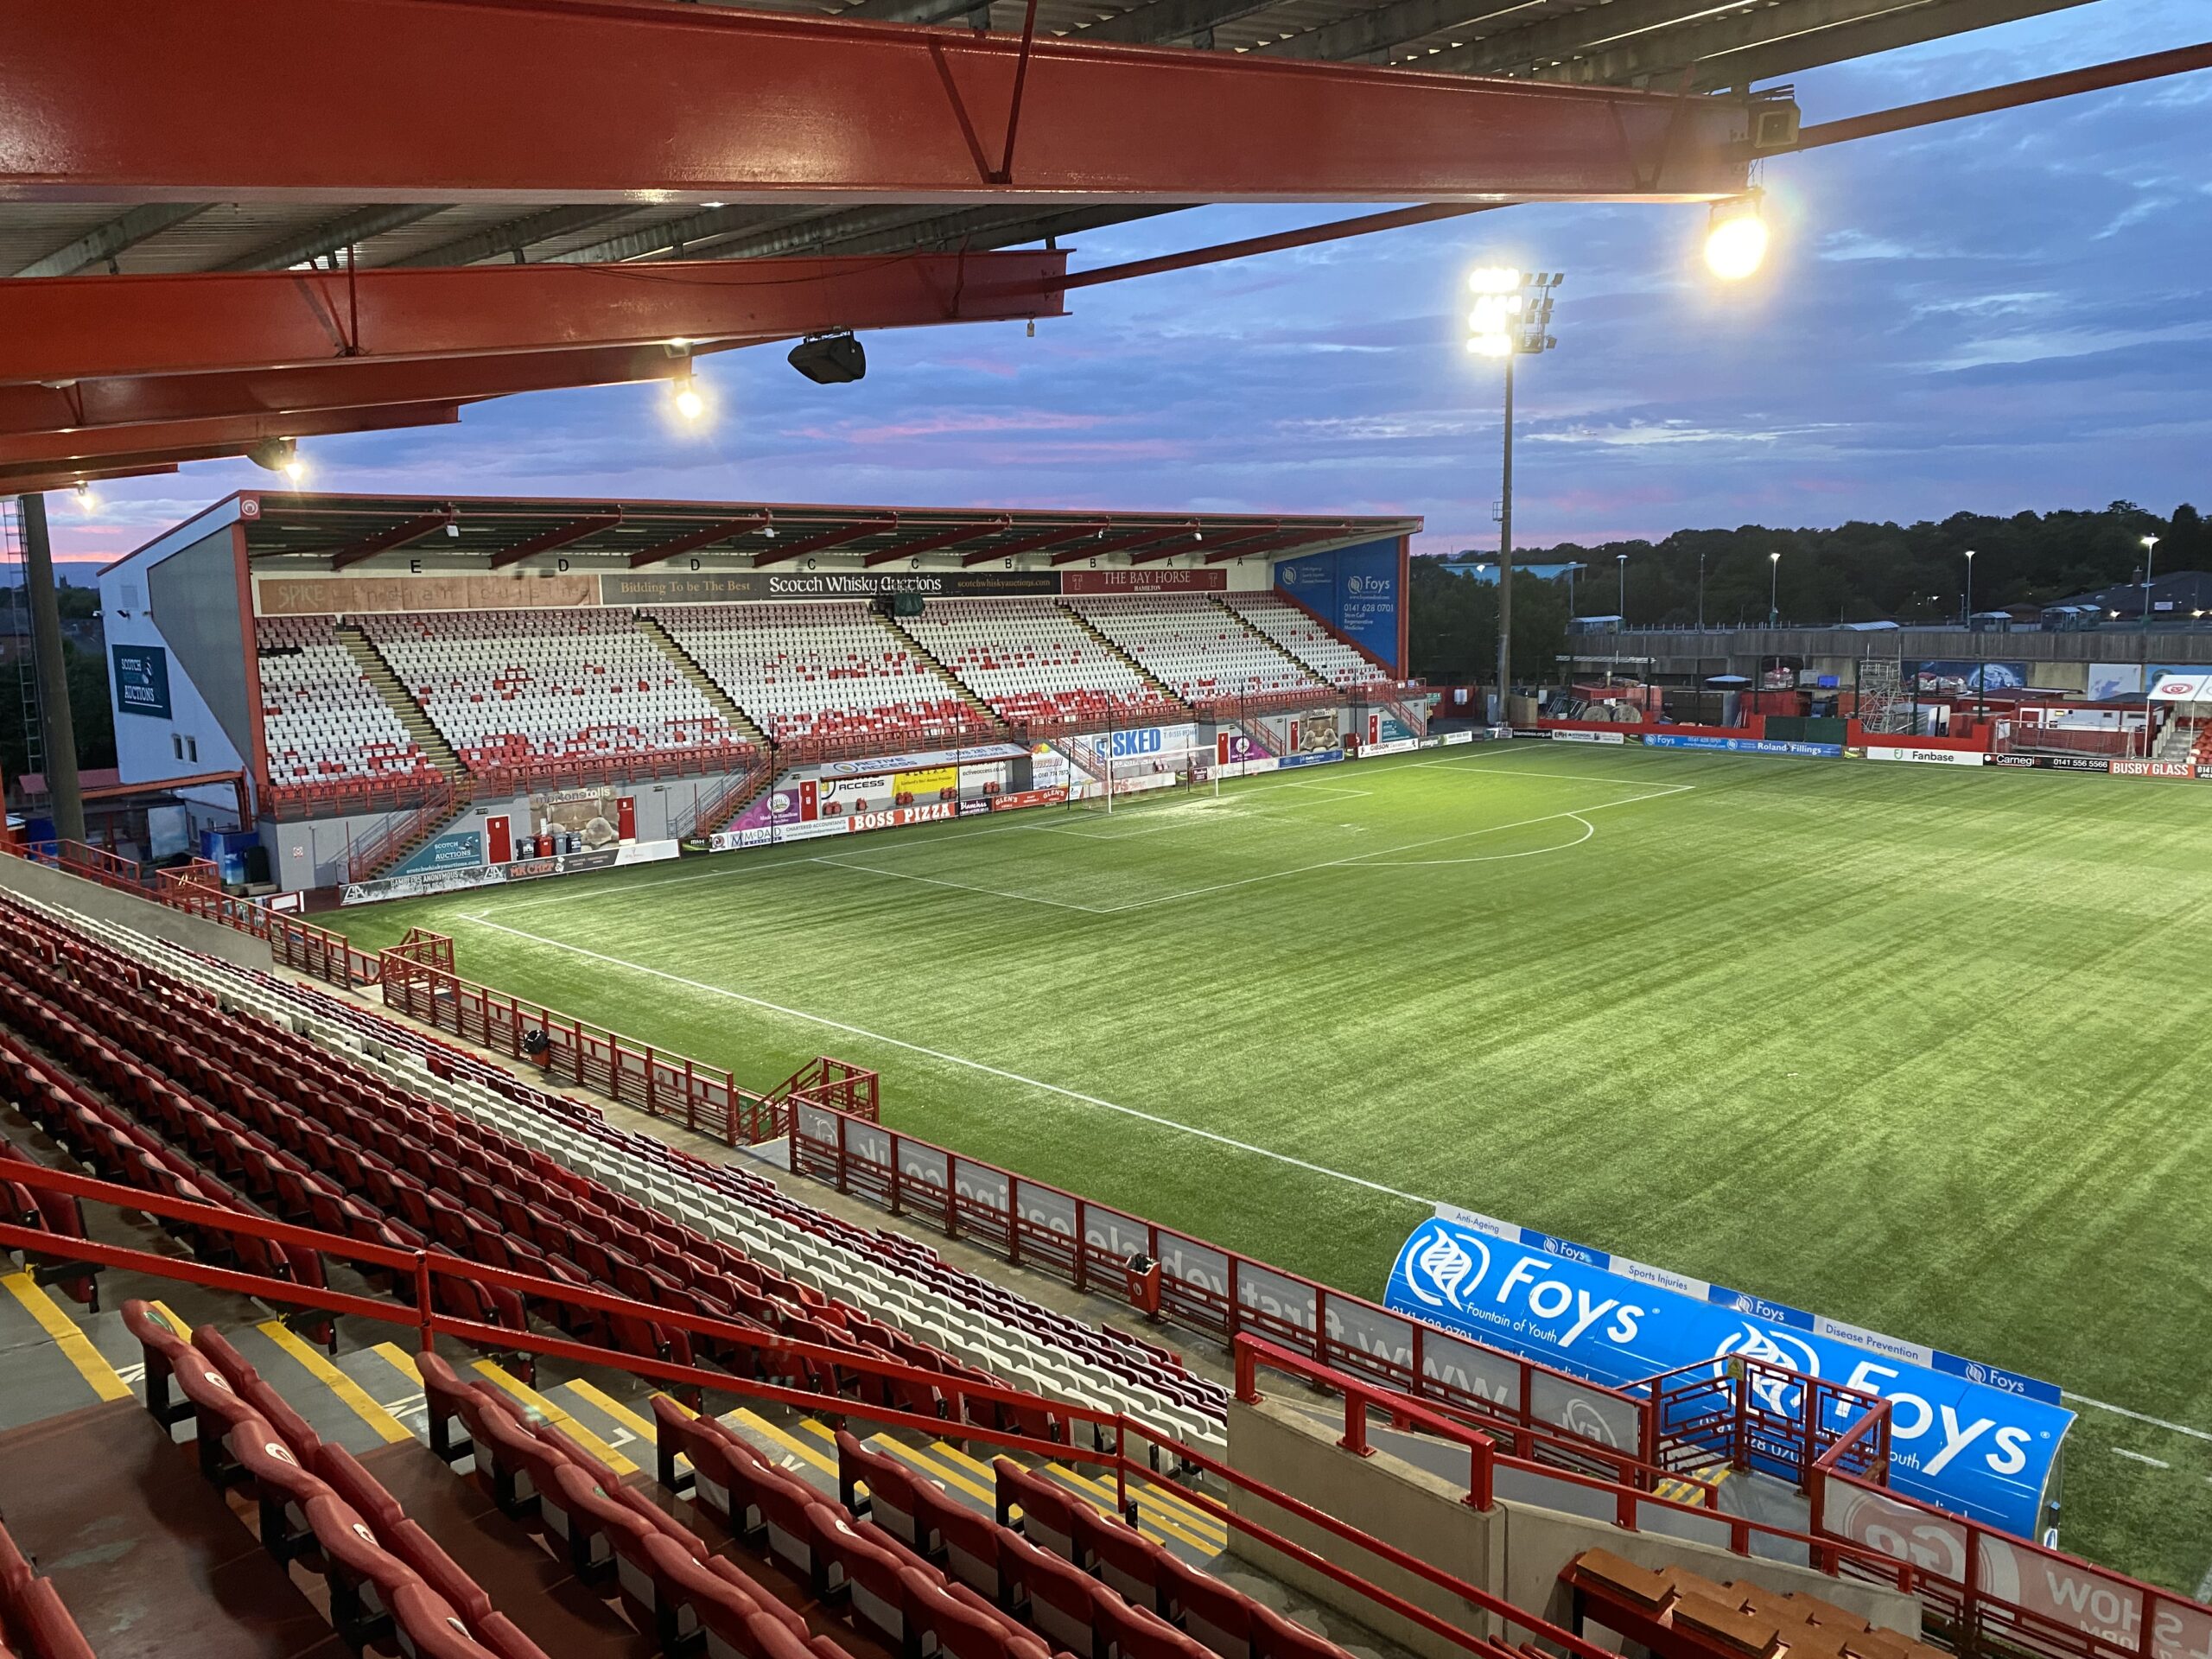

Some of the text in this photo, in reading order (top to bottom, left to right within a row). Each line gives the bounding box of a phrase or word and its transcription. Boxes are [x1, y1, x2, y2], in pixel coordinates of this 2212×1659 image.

[410, 559, 422, 574] E
[557, 558, 569, 572] D
[690, 558, 701, 571] D
[806, 558, 817, 570] C
[911, 557, 919, 569] C
[1005, 558, 1013, 569] B
[1090, 557, 1096, 568] B
[1166, 557, 1173, 568] A
[1237, 557, 1243, 566] A
[1103, 570, 1191, 586] THE BAY HORSE
[1365, 575, 1390, 594] Foys
[620, 582, 666, 595] Bidding
[671, 581, 683, 593] To
[702, 581, 725, 592] The
[727, 580, 751, 591] Best
[769, 576, 823, 593] Scotch
[825, 575, 879, 595] Whisky
[1344, 603, 1359, 612] 0141
[1376, 603, 1394, 612] 0701
[121, 658, 142, 671] SCOTCH
[124, 684, 155, 702] AUCTIONS
[1112, 728, 1161, 757] SKED
[1657, 734, 1675, 747] Foys
[1757, 742, 1788, 752] Roland
[1791, 744, 1821, 756] Fillings
[855, 757, 906, 766] ACTIVE
[1912, 750, 1955, 762] Fanbase
[2053, 758, 2070, 766] 0141
[2113, 762, 2151, 775] BUSBY
[2152, 763, 2189, 776] GLASS
[2197, 766, 2212, 774] 014
[838, 779, 885, 791] ACCESS
[995, 795, 1019, 805] GLEN'S
[1043, 789, 1065, 799] GLEN'S
[854, 810, 895, 830] BOSS
[903, 803, 951, 823] PIZZA
[744, 826, 782, 841] McDAD
[434, 841, 459, 849] SCOTCH
[435, 849, 471, 861] AUCTIONS
[423, 871, 460, 883] ANONYMOUS
[1456, 1211, 1500, 1235] Anti-Ageing
[1560, 1242, 1586, 1261] Foys
[1628, 1264, 1688, 1292] Sports Injuries
[1496, 1255, 1645, 1348] Foys
[1756, 1300, 1785, 1322] Foys
[1466, 1301, 1558, 1344] Fountain of Youth
[1825, 1323, 1919, 1361] Disease Prevention
[1989, 1370, 2024, 1395] Foys
